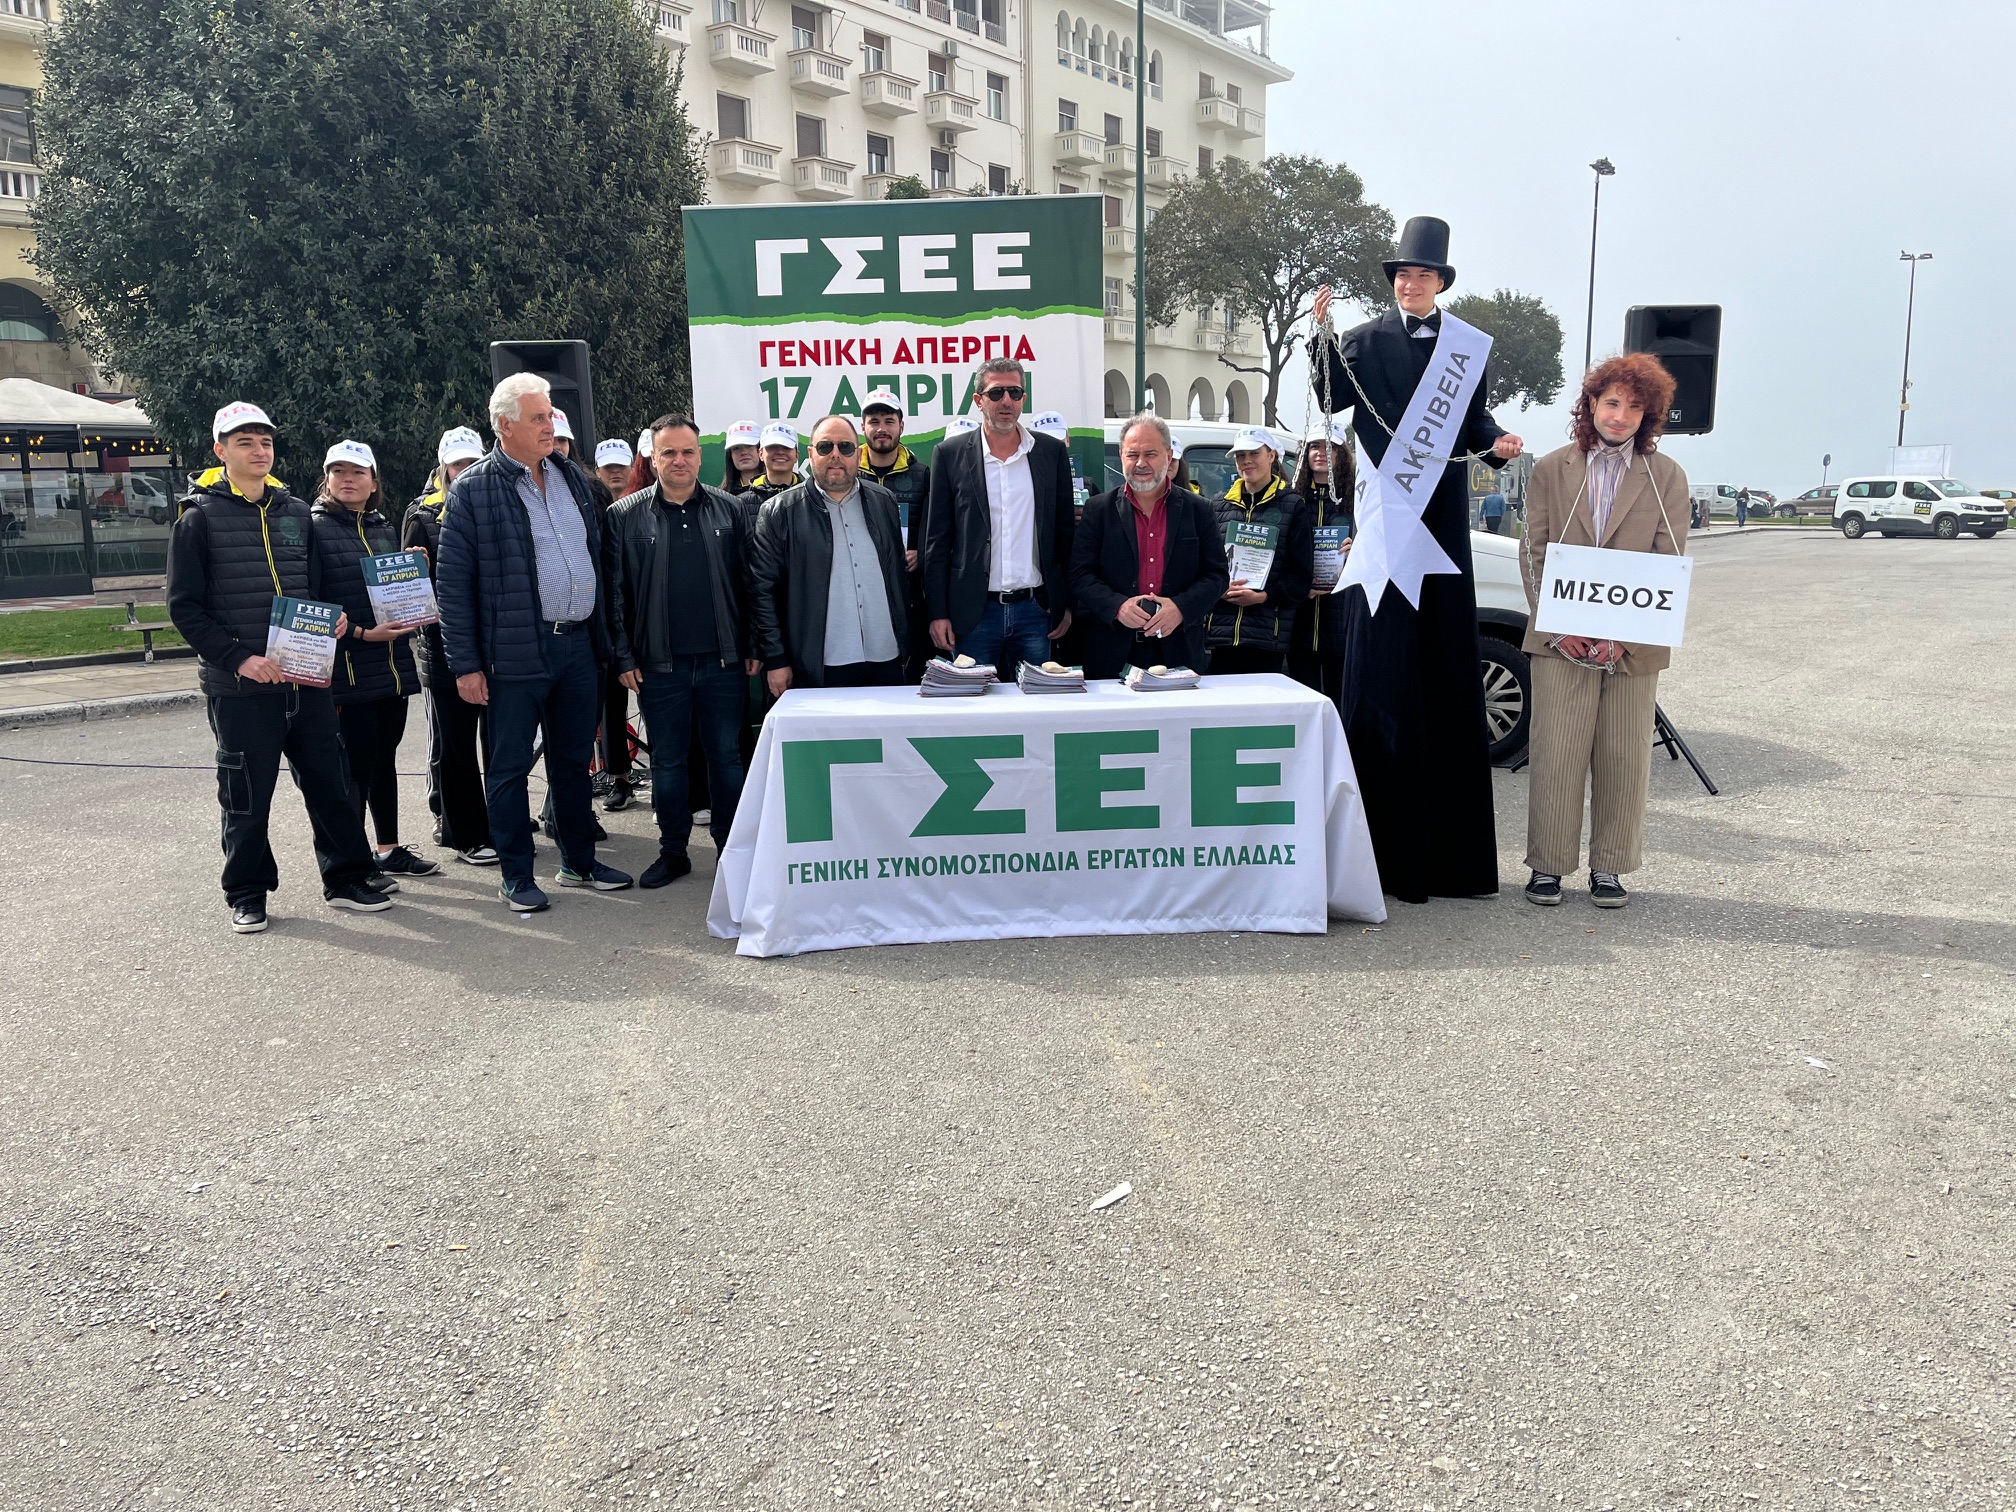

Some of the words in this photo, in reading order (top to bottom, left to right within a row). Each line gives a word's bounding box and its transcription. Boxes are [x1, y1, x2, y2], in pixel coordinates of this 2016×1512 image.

[755, 231, 1031, 297] ΓΣΕΕ
[759, 337, 882, 368] ΓΕΝΙΚΗ
[892, 334, 1036, 365] ΑΠΕΡΓΙΑ
[759, 376, 812, 419] 17
[1393, 351, 1470, 494] ΑΚΡΙΒΕΙΑ
[1238, 523, 1270, 535] ΓΣΕΕ
[375, 554, 415, 567] ΓΣΕΕ
[391, 570, 420, 581] ΑΠΡΙΛΗ
[297, 603, 331, 618] ΓΣΕΕ
[1552, 578, 1674, 611] ΜΙΣΘΟΣ
[304, 624, 330, 634] ΑΠΡΙΛΗ
[781, 723, 1296, 844] ΓΣΕΕ
[787, 857, 868, 885] ΓΕΝΙΚΗ
[876, 849, 1080, 879] ΣΥΝΟΜΟΣΠΟΝΔΙΑ
[1087, 846, 1184, 870] ΕΡΓΑΤΩΝ
[1193, 843, 1296, 867] ΕΛΛΑΔΑΣ
